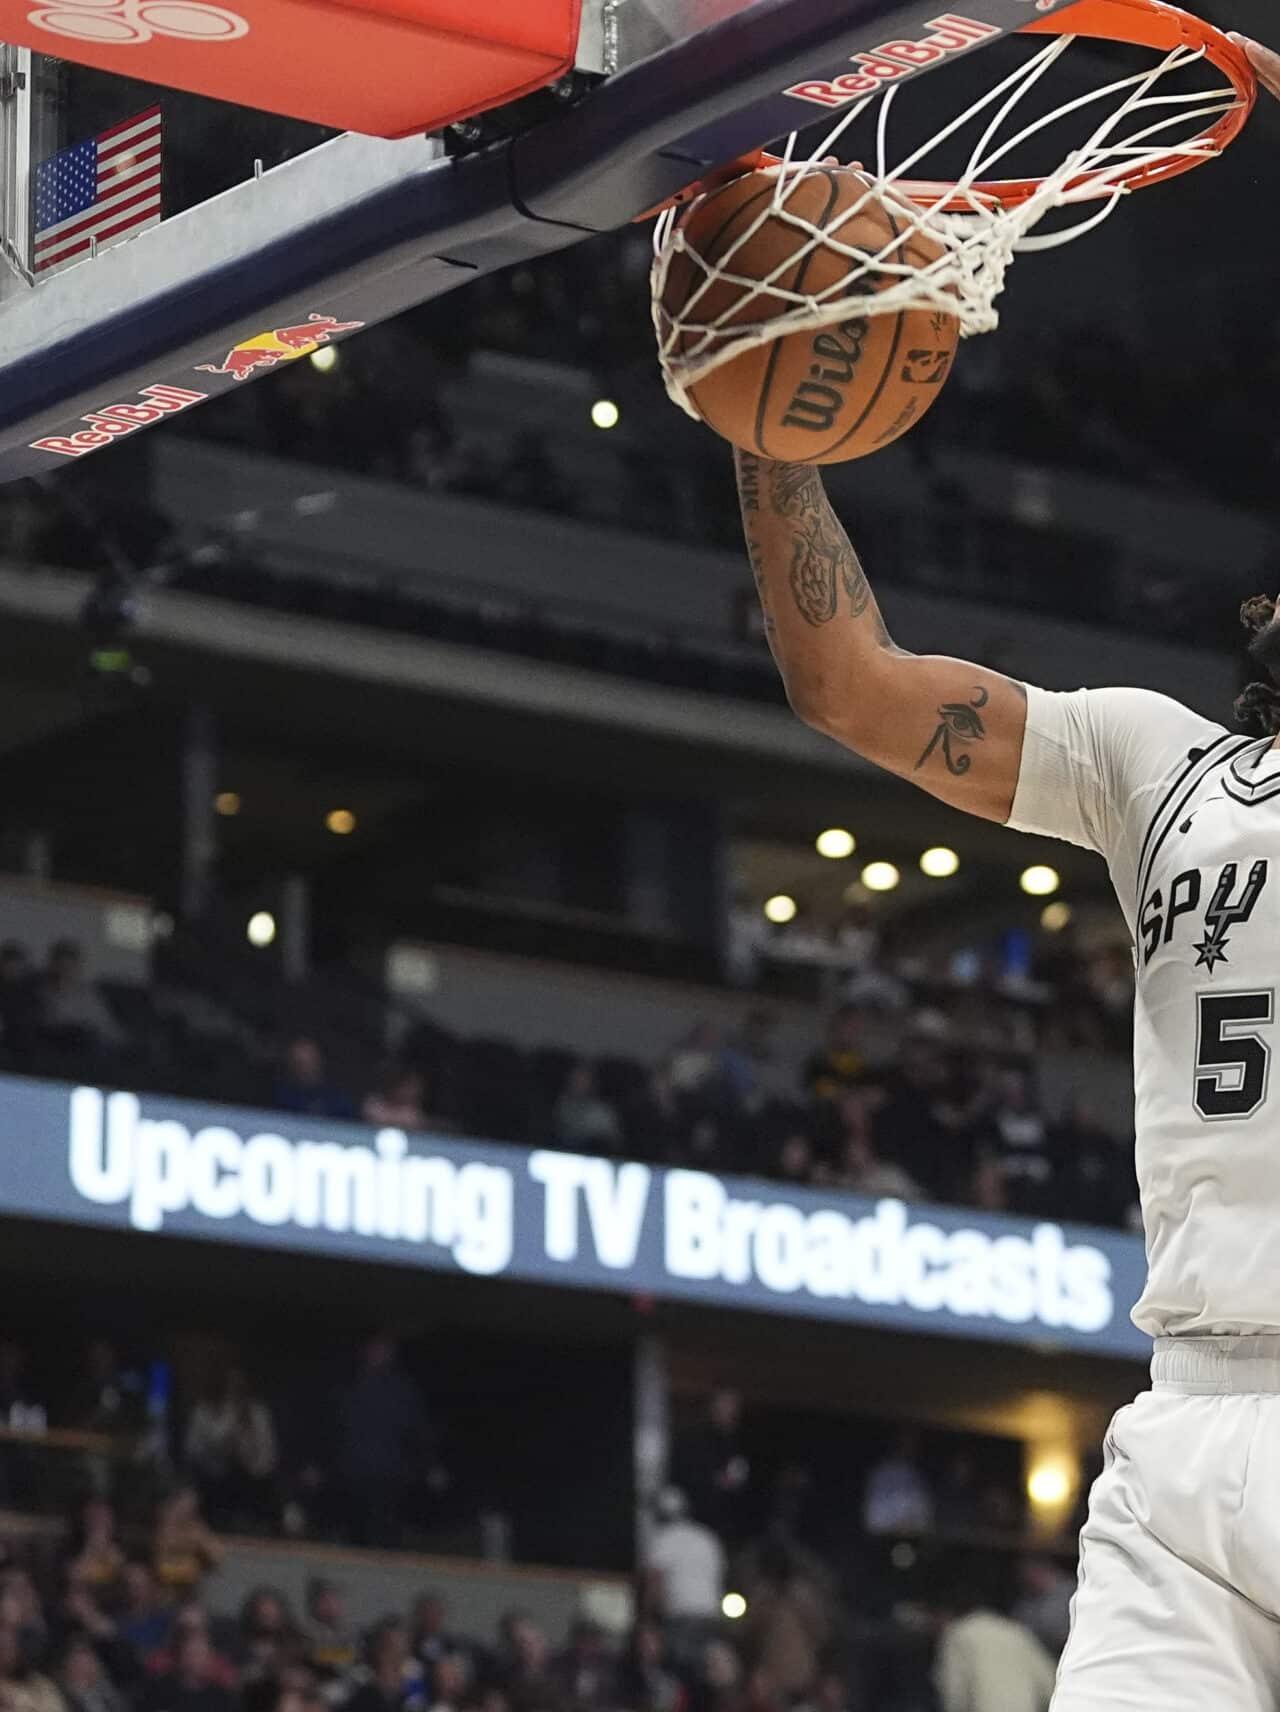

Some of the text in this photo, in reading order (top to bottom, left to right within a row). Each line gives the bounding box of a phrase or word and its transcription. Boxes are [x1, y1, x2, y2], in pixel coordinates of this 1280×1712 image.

[1192, 987, 1275, 1122] 5
[68, 1086, 1114, 1333] Upcoming TV Broadcasts
